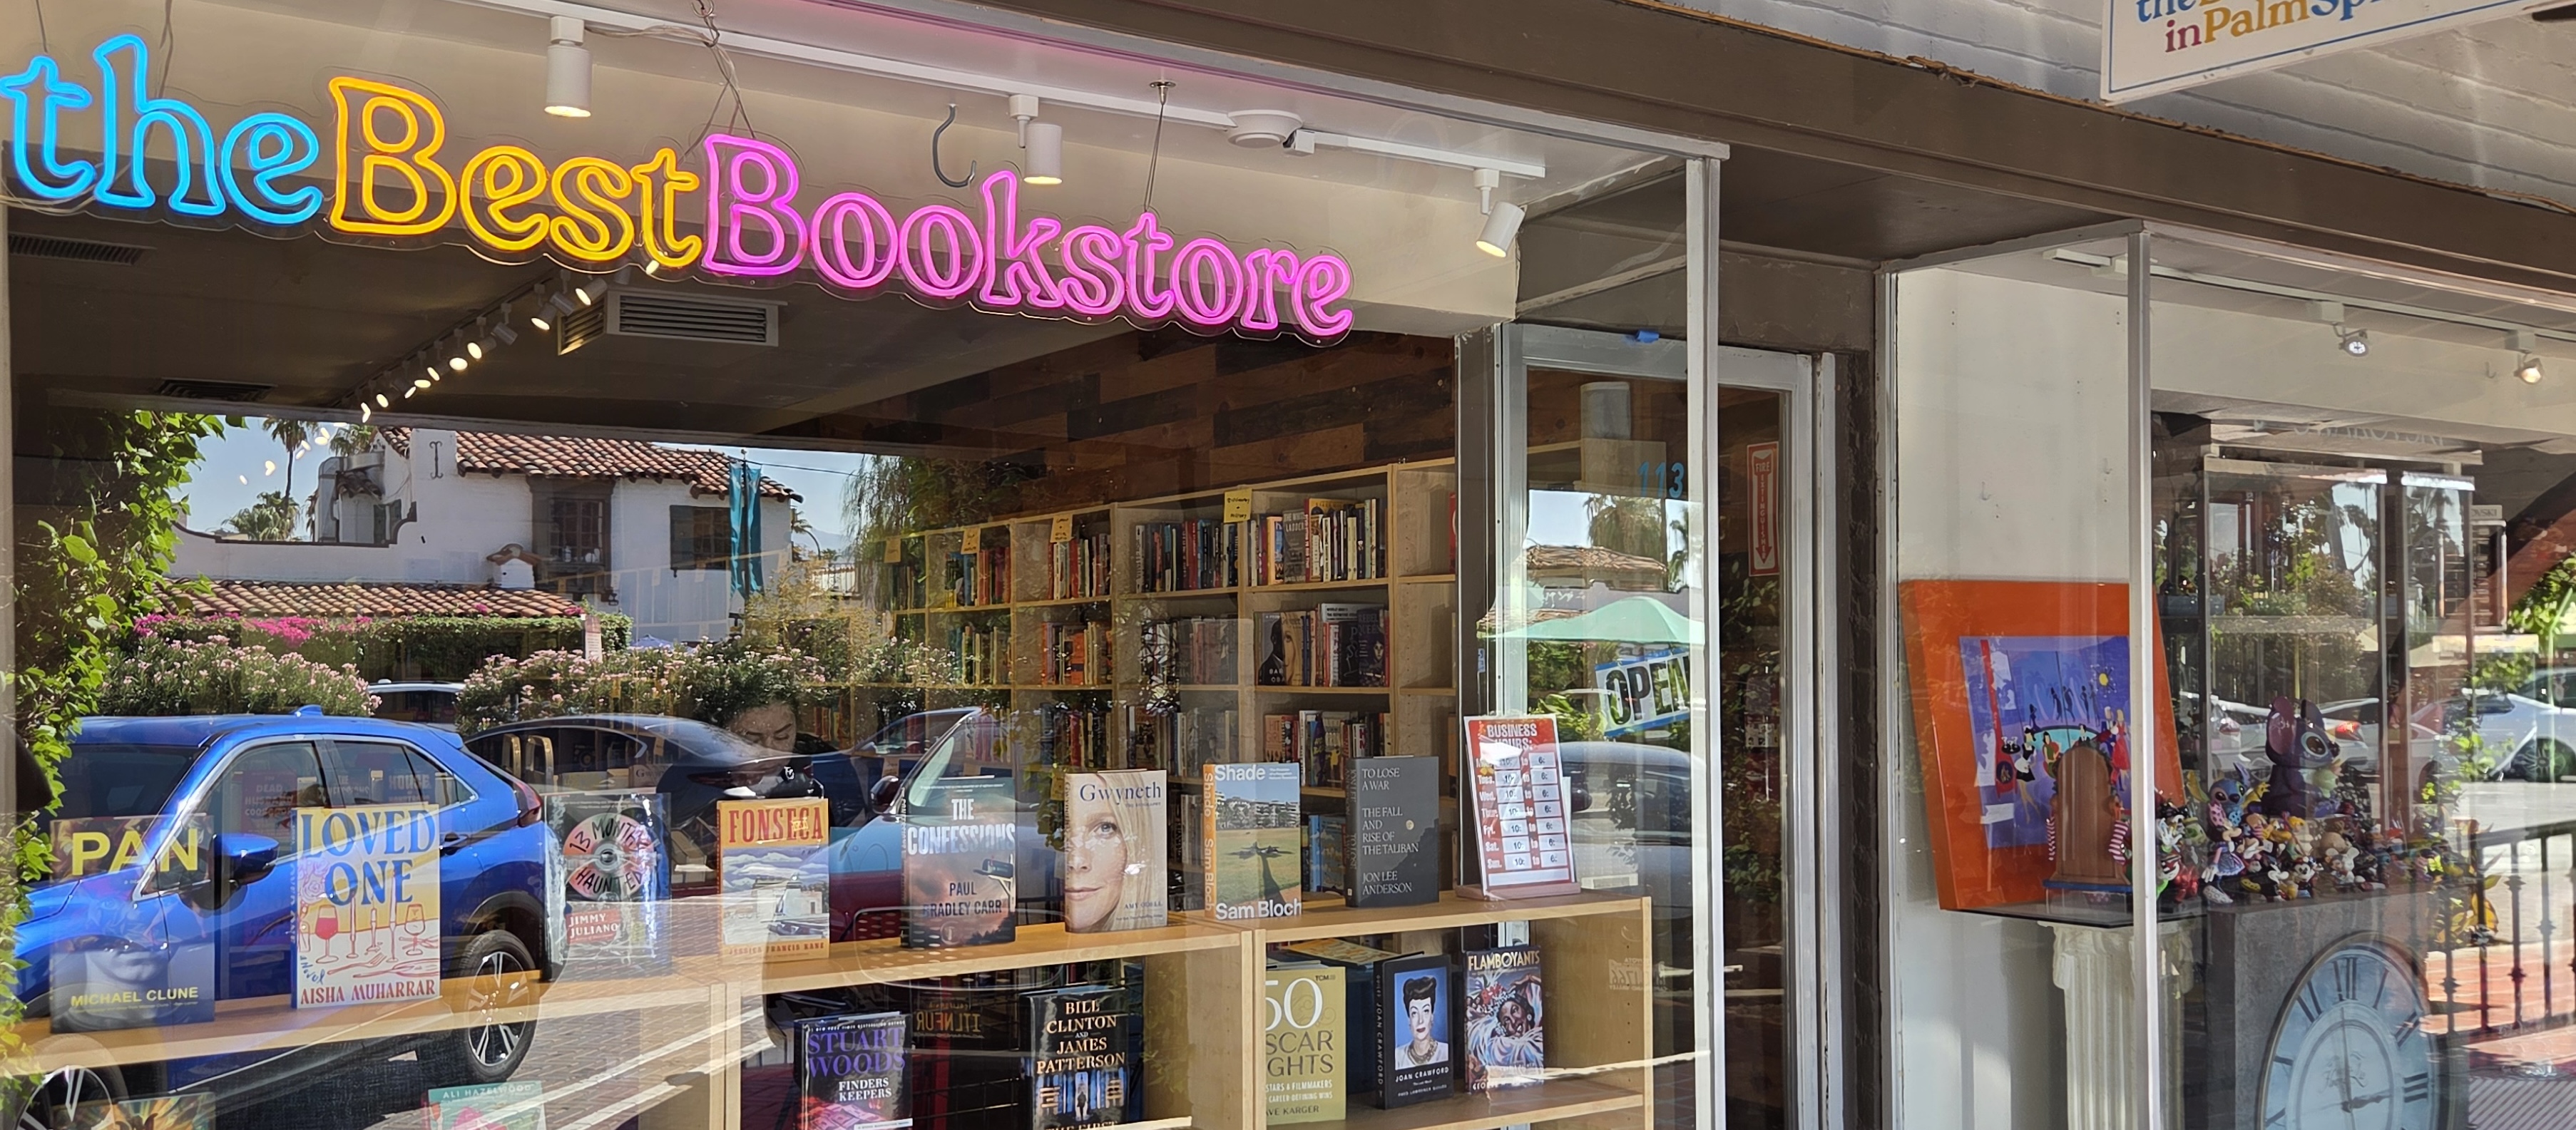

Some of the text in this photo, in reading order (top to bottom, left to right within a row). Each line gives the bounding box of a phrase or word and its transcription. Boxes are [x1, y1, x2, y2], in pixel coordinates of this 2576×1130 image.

[1755, 461, 1771, 473] FIRE
[1636, 461, 1685, 498] 113
[1606, 656, 1689, 725] OPEN
[1487, 723, 1538, 738] BUSINESS
[1215, 764, 1266, 781] Shade
[1361, 767, 1400, 778] TO LOSE
[1080, 781, 1161, 805] Gwyneth
[1362, 780, 1389, 791] A WAR
[1204, 772, 1214, 817] Shade
[1479, 791, 1496, 801] Wed.
[1525, 790, 1533, 798] to
[1542, 789, 1549, 798] 6:
[951, 798, 975, 821] THE
[1361, 806, 1404, 818] THE FALL
[1545, 805, 1552, 813] 6:
[728, 806, 824, 843] FONSECA
[1362, 820, 1383, 831] AND
[1528, 823, 1536, 832] to
[300, 809, 436, 858] LOVED
[907, 823, 1016, 856] CONFESSIONS
[1362, 832, 1381, 843] RISE
[1382, 831, 1395, 841] OF
[569, 831, 591, 853] 13
[1362, 843, 1419, 856] THE TALIBAN
[1486, 841, 1499, 852] Sat.
[1530, 838, 1538, 849] to
[1548, 838, 1555, 846] 6:
[72, 828, 198, 876] PAN
[1487, 858, 1503, 869] Sun.
[1533, 856, 1540, 866] to
[324, 859, 414, 906] ONE
[1204, 838, 1215, 912] Sam Bloch
[1362, 870, 1398, 885] JON LEE
[949, 881, 977, 896] PAUL
[1362, 882, 1412, 895] ANDERSON
[923, 899, 1002, 918] BRADLEY CARR
[1215, 898, 1303, 920] Sam Bloch
[568, 913, 607, 928] JIMMY
[569, 923, 619, 939] JULIANO
[766, 943, 800, 953] FRANCIS
[804, 942, 824, 950] KANE
[1468, 950, 1540, 971] FLAMBOYANTS
[71, 990, 143, 1007] MICHAEL
[145, 987, 199, 1002] CLUNE
[300, 980, 436, 1005] AISHA MUHARRAR
[1065, 1000, 1101, 1015] BILL
[1046, 1015, 1118, 1034] CLINTON
[807, 1027, 906, 1055] STUART
[1056, 1037, 1108, 1055] JAMES
[1266, 1030, 1334, 1055] SCAR
[1036, 1052, 1125, 1074] PATTERSON
[1395, 1073, 1413, 1083] JOAN
[1414, 1067, 1449, 1079] CRAWFORD
[839, 1077, 889, 1092] FINDERS
[1266, 1082, 1284, 1092] STARS
[1292, 1079, 1333, 1091] FILMMAKERS
[442, 1089, 460, 1099] ALI
[839, 1087, 892, 1101] KEEPERS
[1283, 1104, 1319, 1115] KARGER
